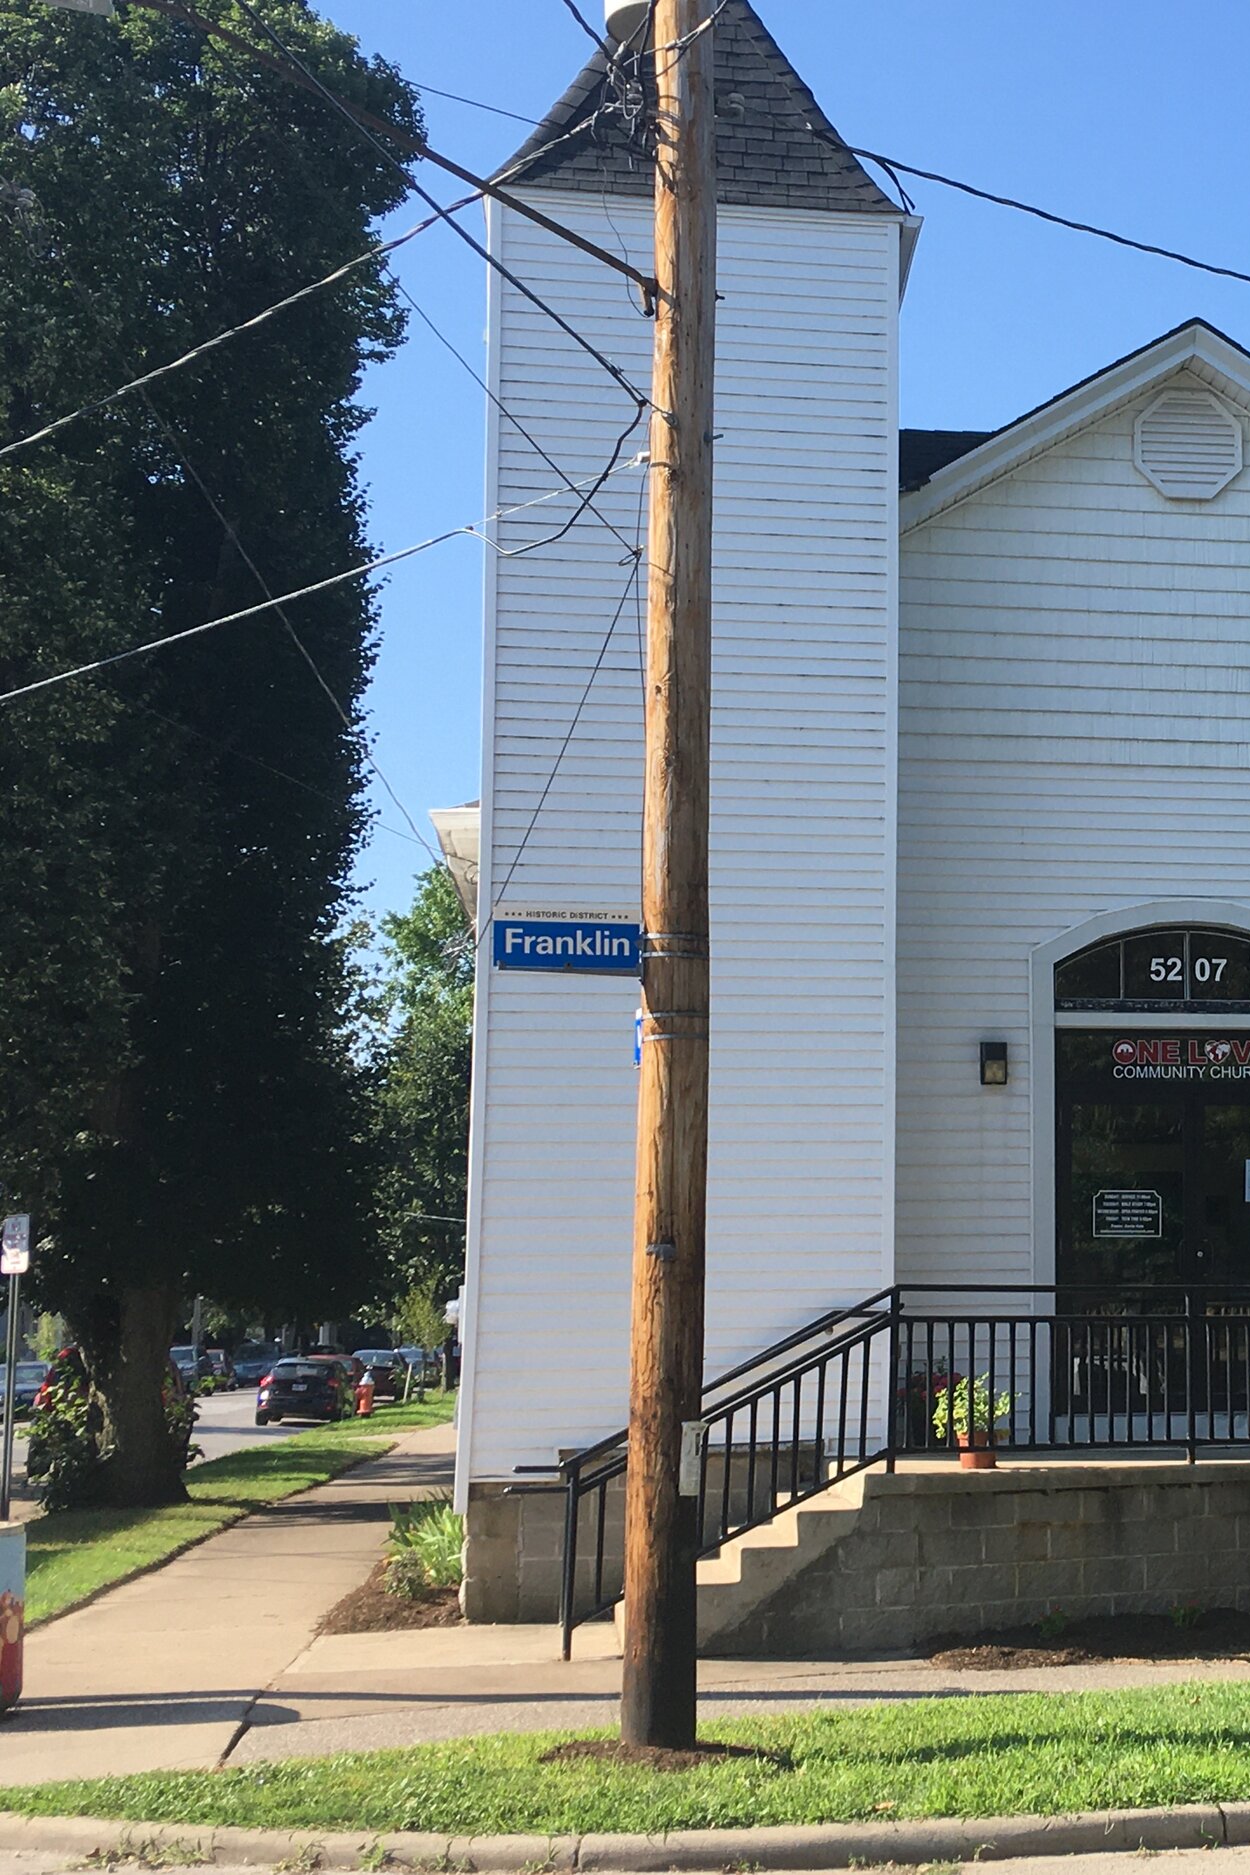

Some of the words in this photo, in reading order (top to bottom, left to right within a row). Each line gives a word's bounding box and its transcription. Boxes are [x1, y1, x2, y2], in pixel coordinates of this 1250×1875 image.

[526, 911, 566, 919] HISTORIC
[570, 912, 609, 920] DISTRICT
[505, 928, 630, 956] Franklin
[1112, 1040, 1181, 1065] ONE
[1113, 1066, 1204, 1079] COMMUNITY
